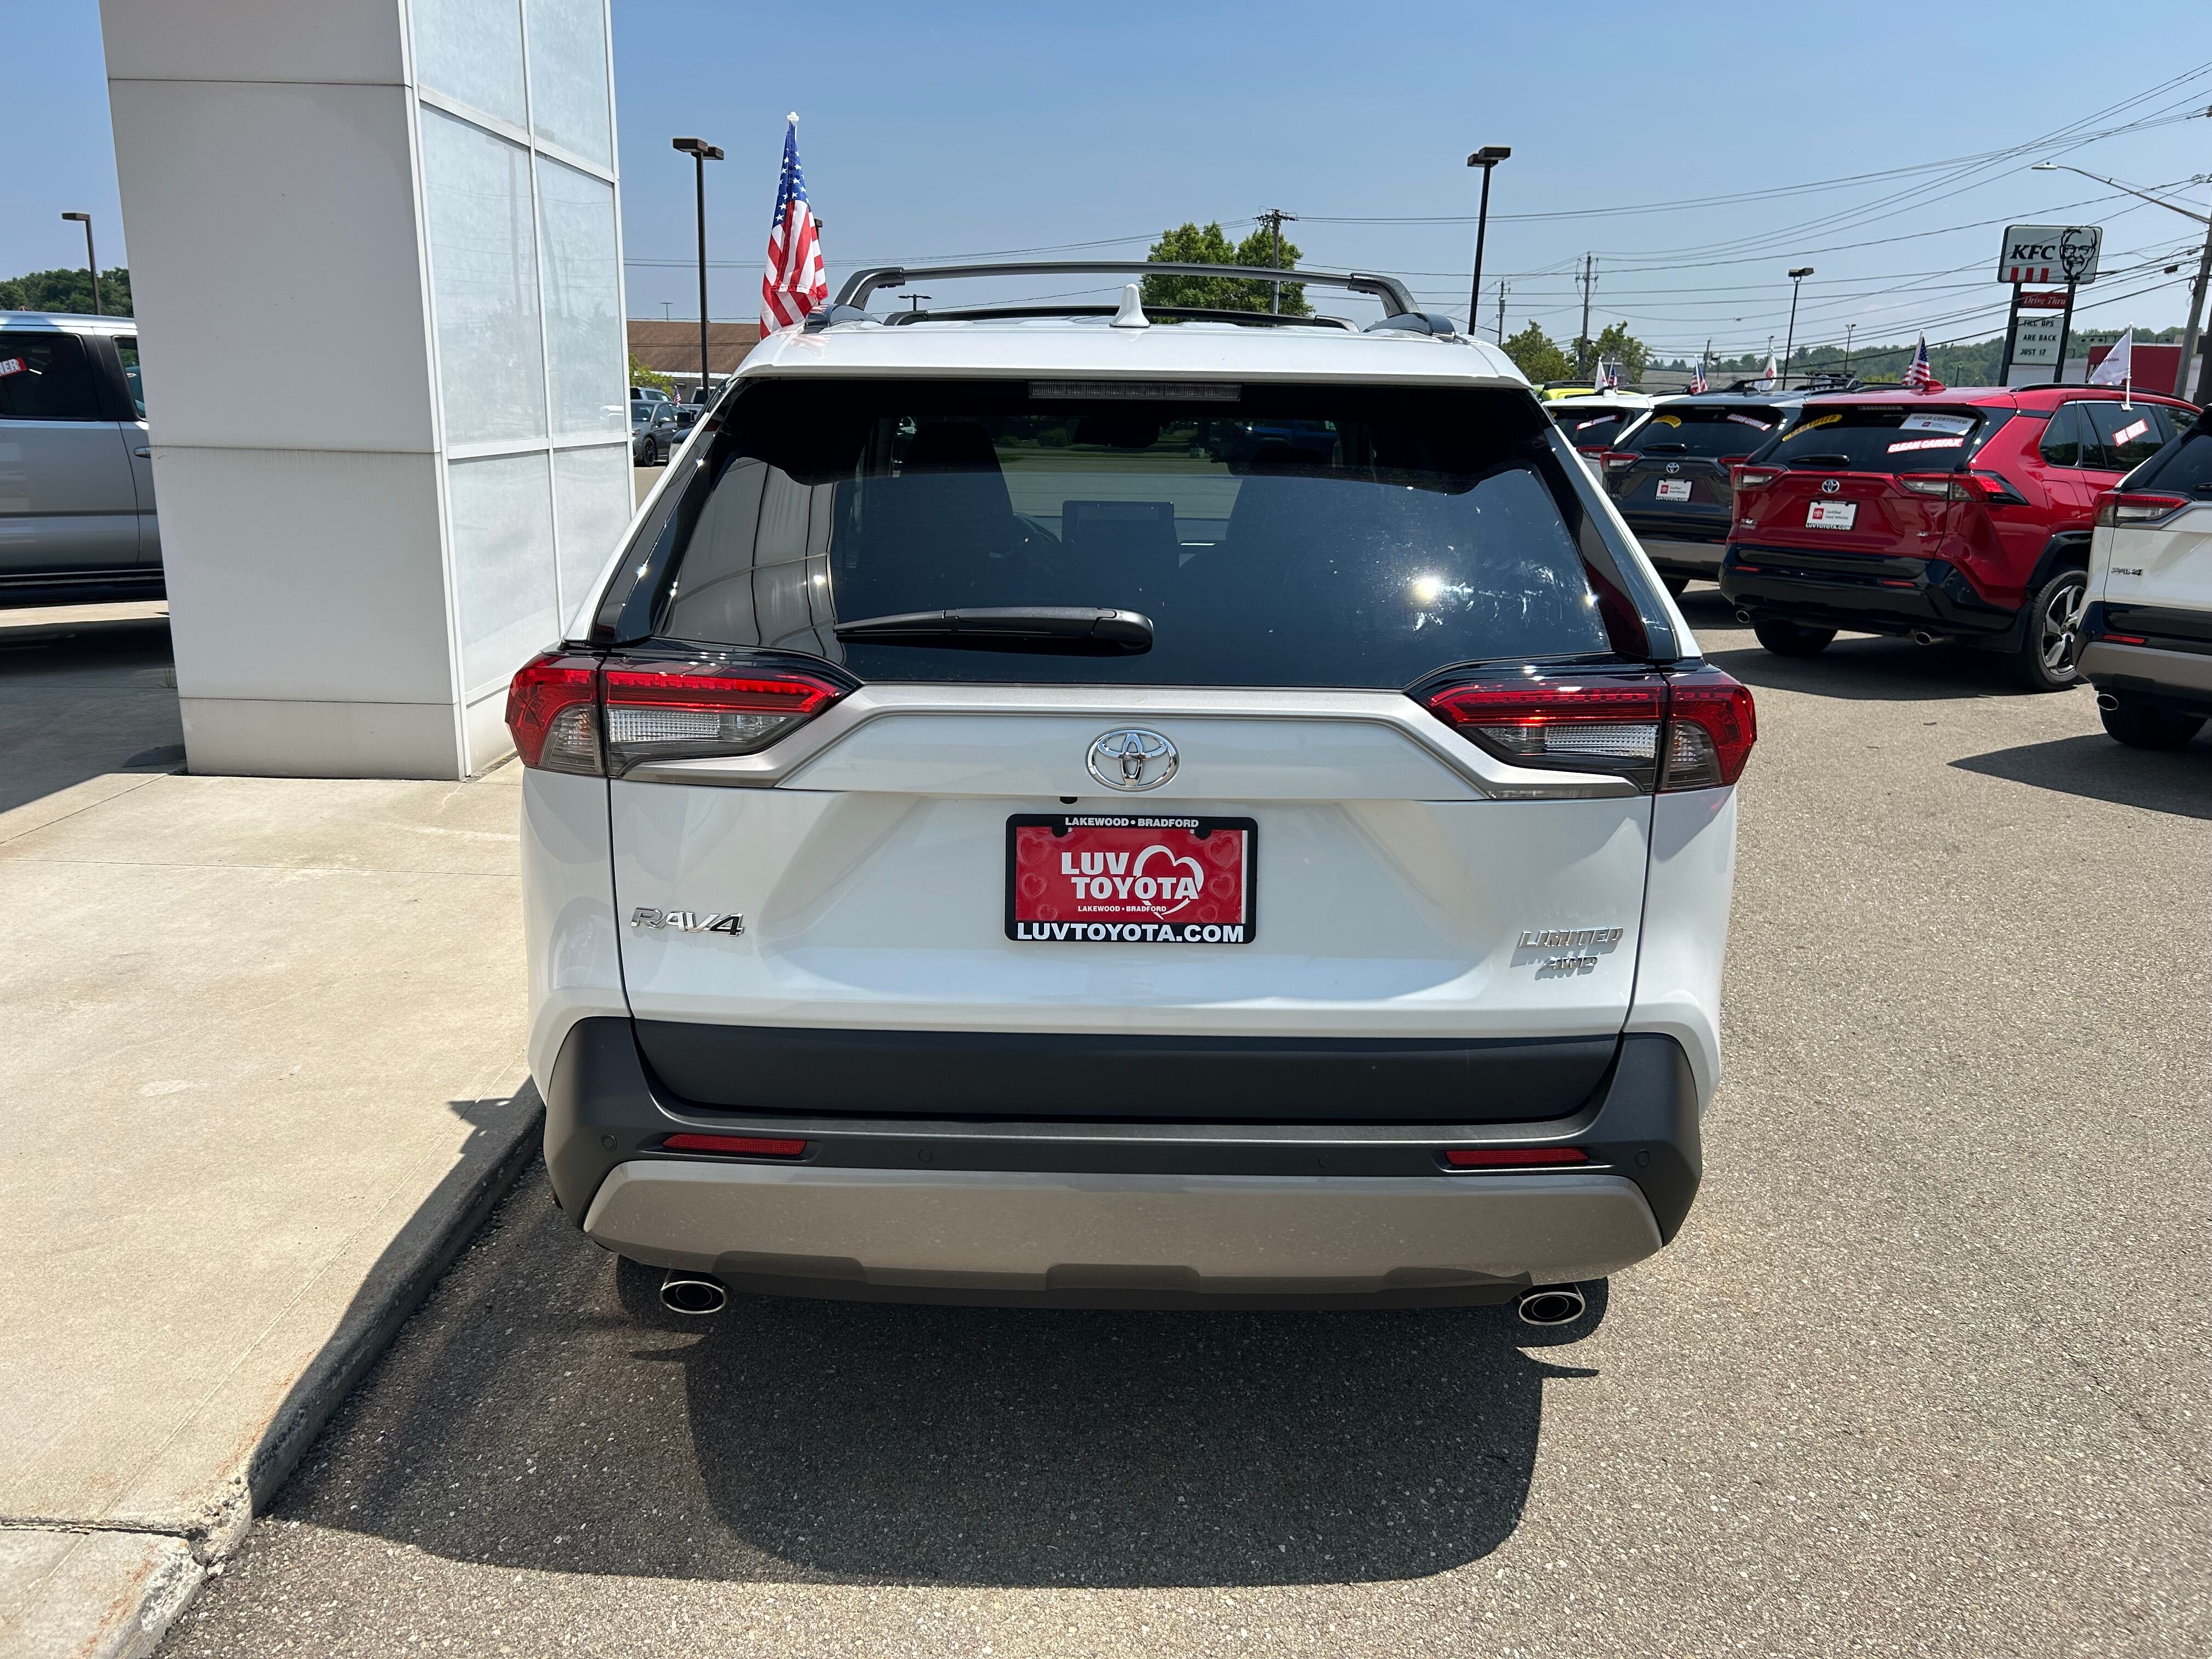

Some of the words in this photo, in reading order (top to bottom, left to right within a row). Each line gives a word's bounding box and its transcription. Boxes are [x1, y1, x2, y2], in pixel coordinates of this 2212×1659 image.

[2010, 245, 2056, 259] KFC
[2024, 296, 2045, 304] Drive
[2047, 297, 2067, 306] Thru
[1933, 416, 1968, 424] CERTIFIED
[1888, 441, 1921, 453] CLEAN
[1921, 438, 1961, 448] CARFAX
[1065, 817, 1128, 826] LAKEWOOD
[1138, 818, 1199, 827] BRADFORD
[1061, 851, 1130, 875] LUV
[1071, 877, 1199, 900] TOYOTA
[630, 907, 744, 936] RAV4
[1017, 922, 1244, 943] LUVTOYOTA.COM
[1518, 927, 1624, 948] LIMITED
